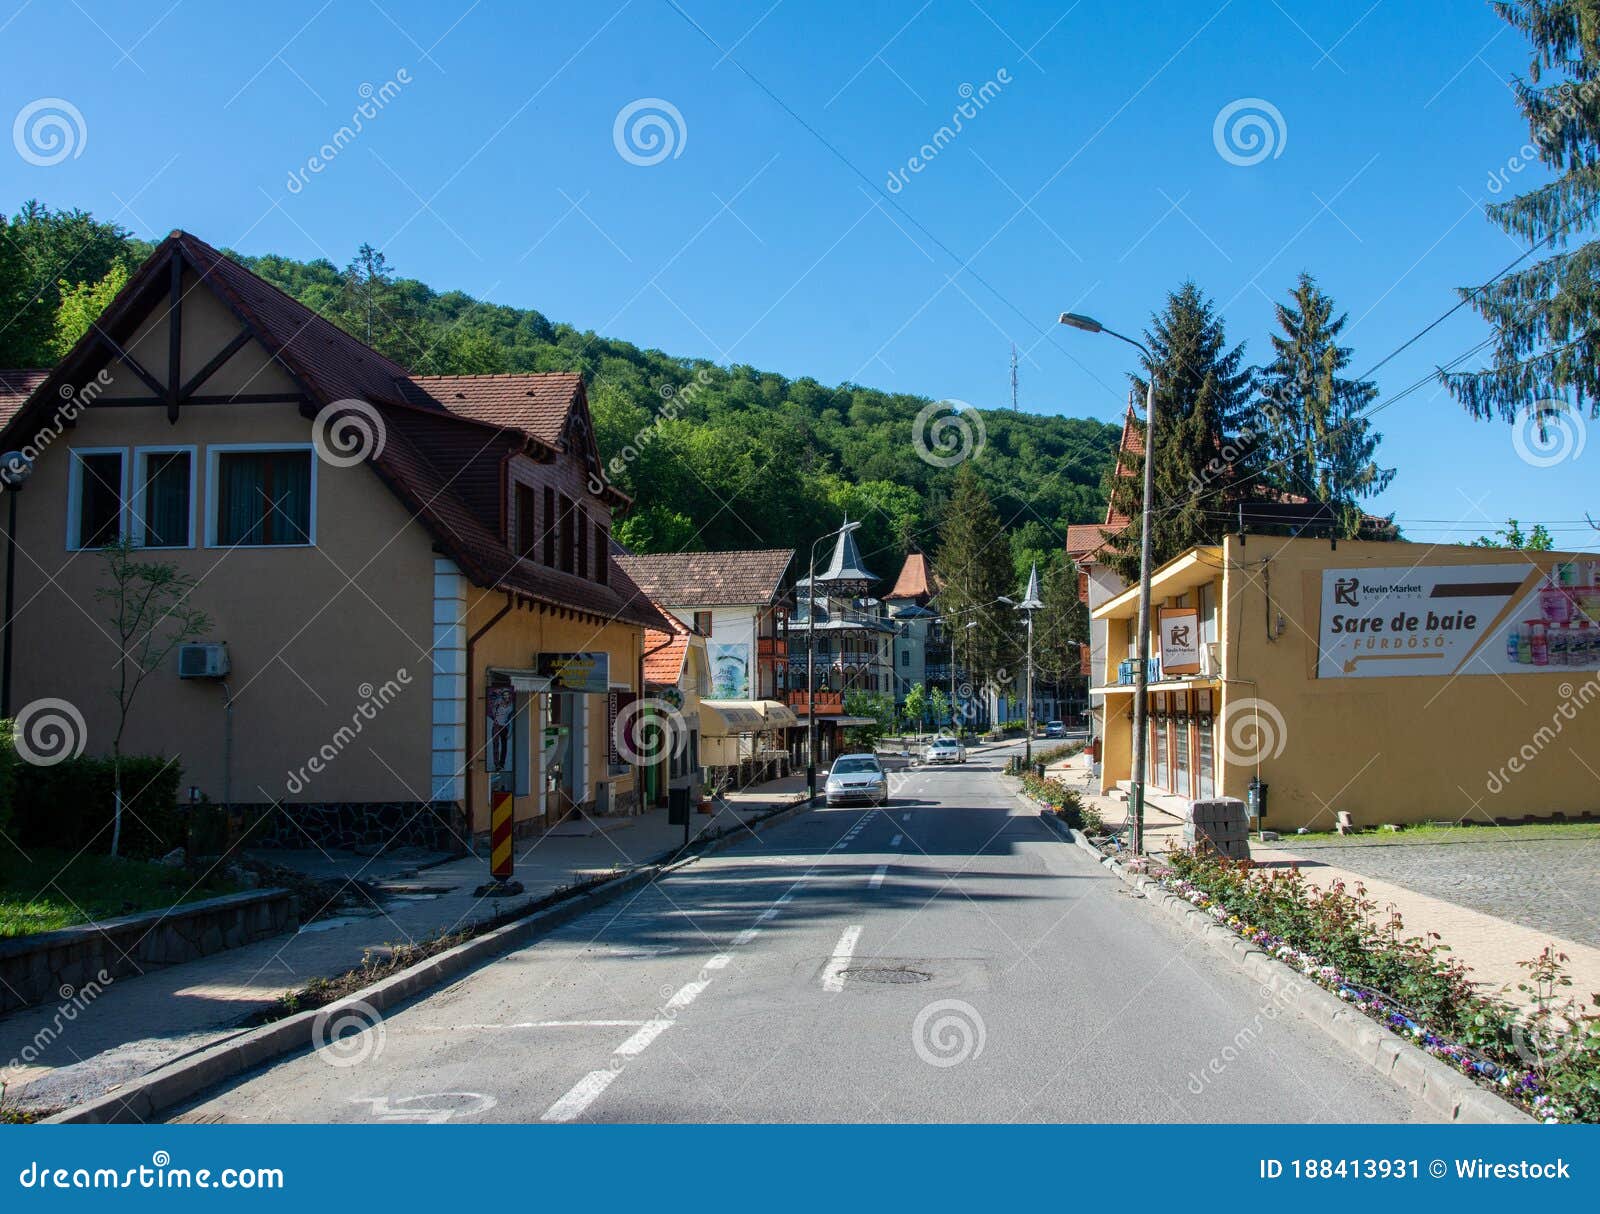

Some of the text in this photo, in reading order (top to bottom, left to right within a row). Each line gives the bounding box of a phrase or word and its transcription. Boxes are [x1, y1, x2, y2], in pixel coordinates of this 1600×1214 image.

[1362, 584, 1421, 593] Kevin Market
[1331, 610, 1477, 633] Sare de baie
